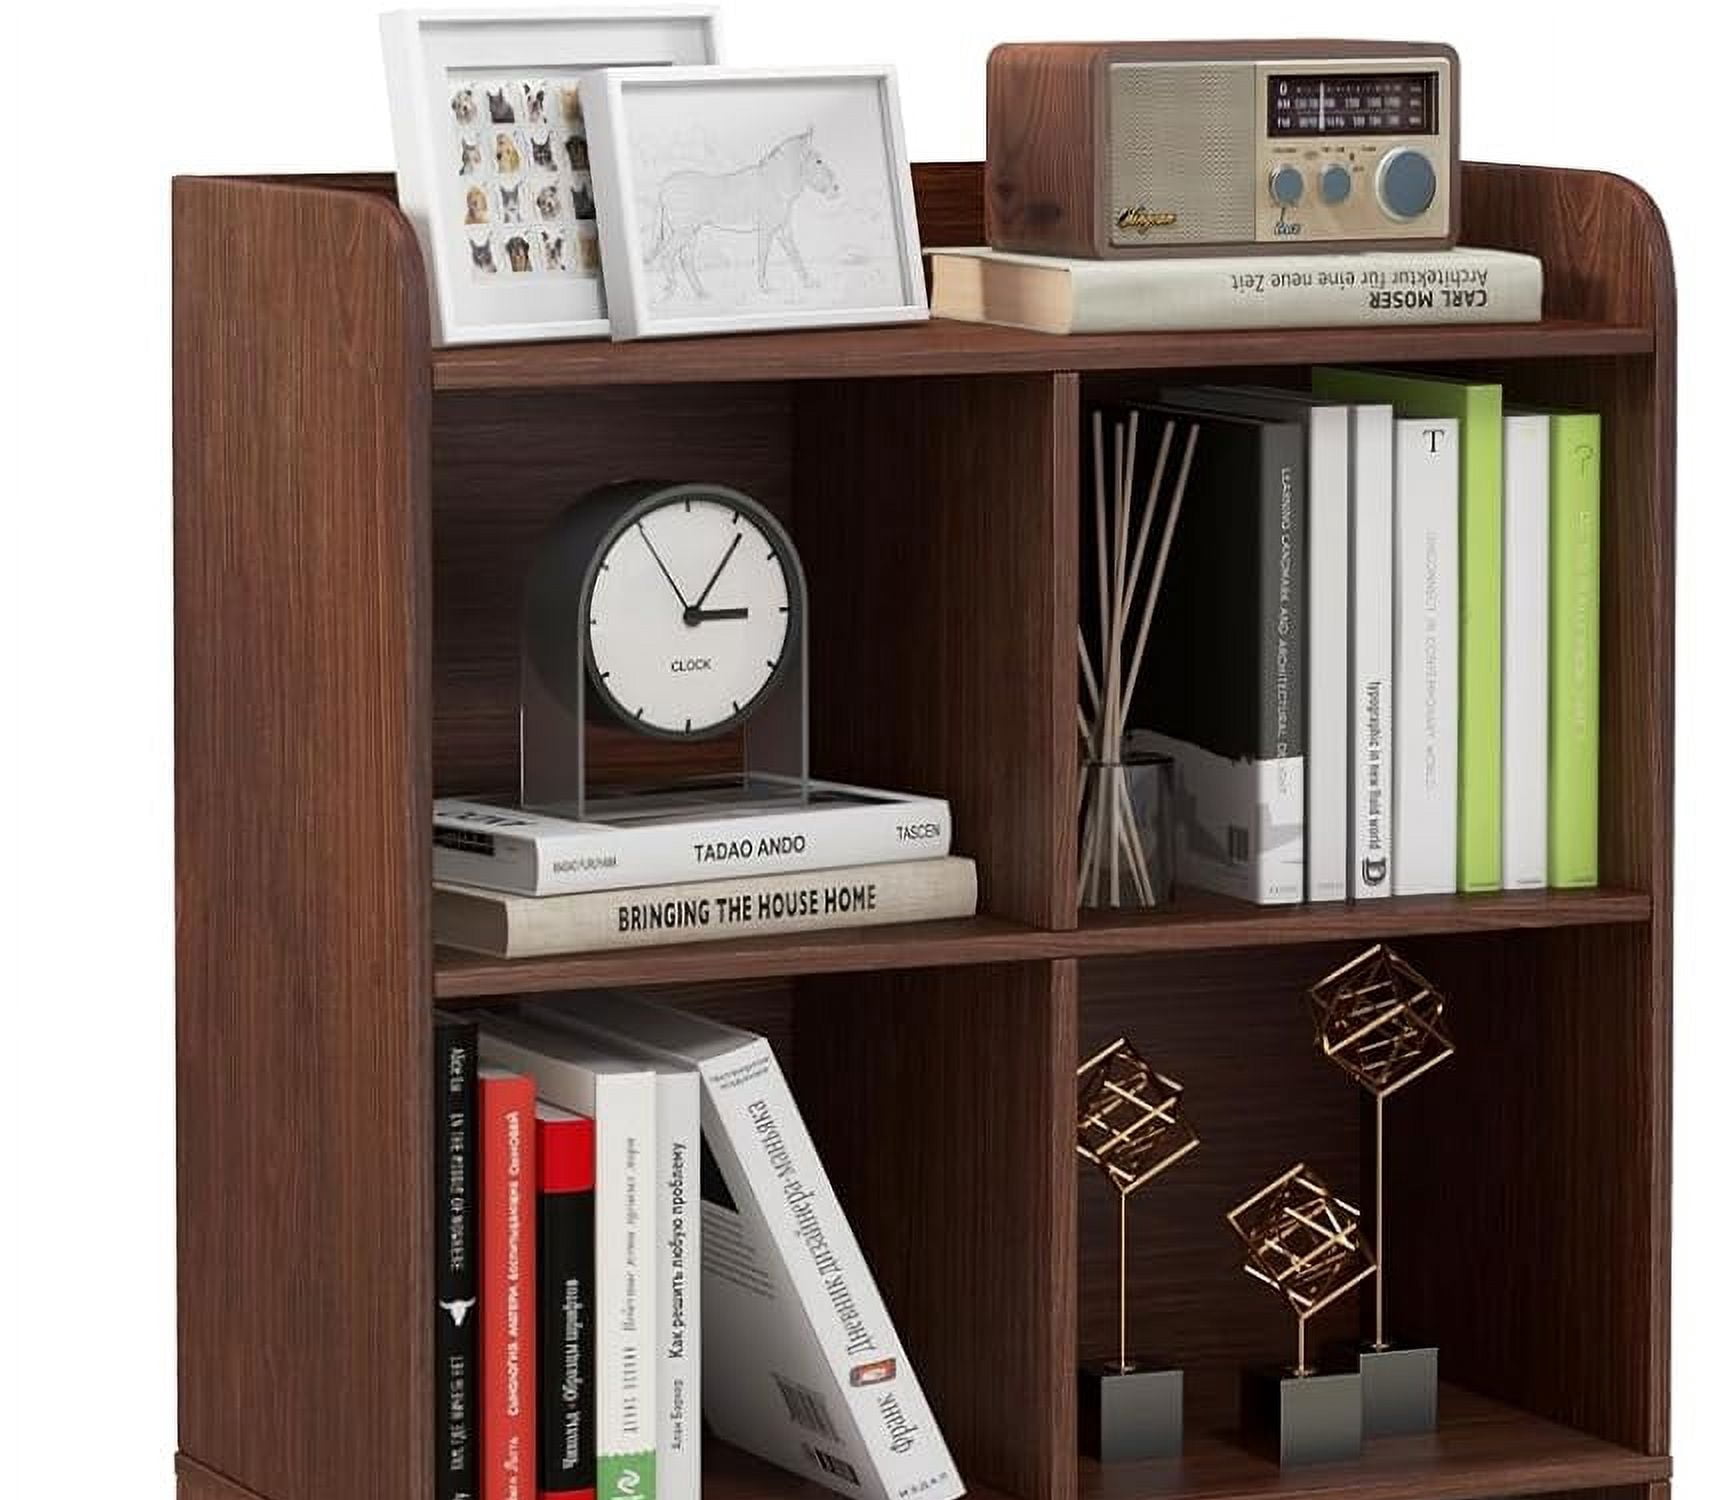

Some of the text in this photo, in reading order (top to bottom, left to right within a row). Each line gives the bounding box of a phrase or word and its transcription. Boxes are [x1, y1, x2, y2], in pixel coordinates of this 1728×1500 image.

[1231, 270, 1488, 293] Architektur für eine neue Zeit
[1368, 290, 1488, 309] CARL MOSER
[1422, 429, 1445, 453] T
[670, 658, 712, 673] CLOCK
[895, 823, 941, 842] TASCEN
[693, 835, 806, 863] TADAO ANDO
[618, 884, 877, 932] BRINGING THE HOUSE HOME
[667, 1142, 687, 1359] Как решить любую проблему
[824, 1279, 876, 1356] Дневник
[878, 1392, 918, 1453] Франк
